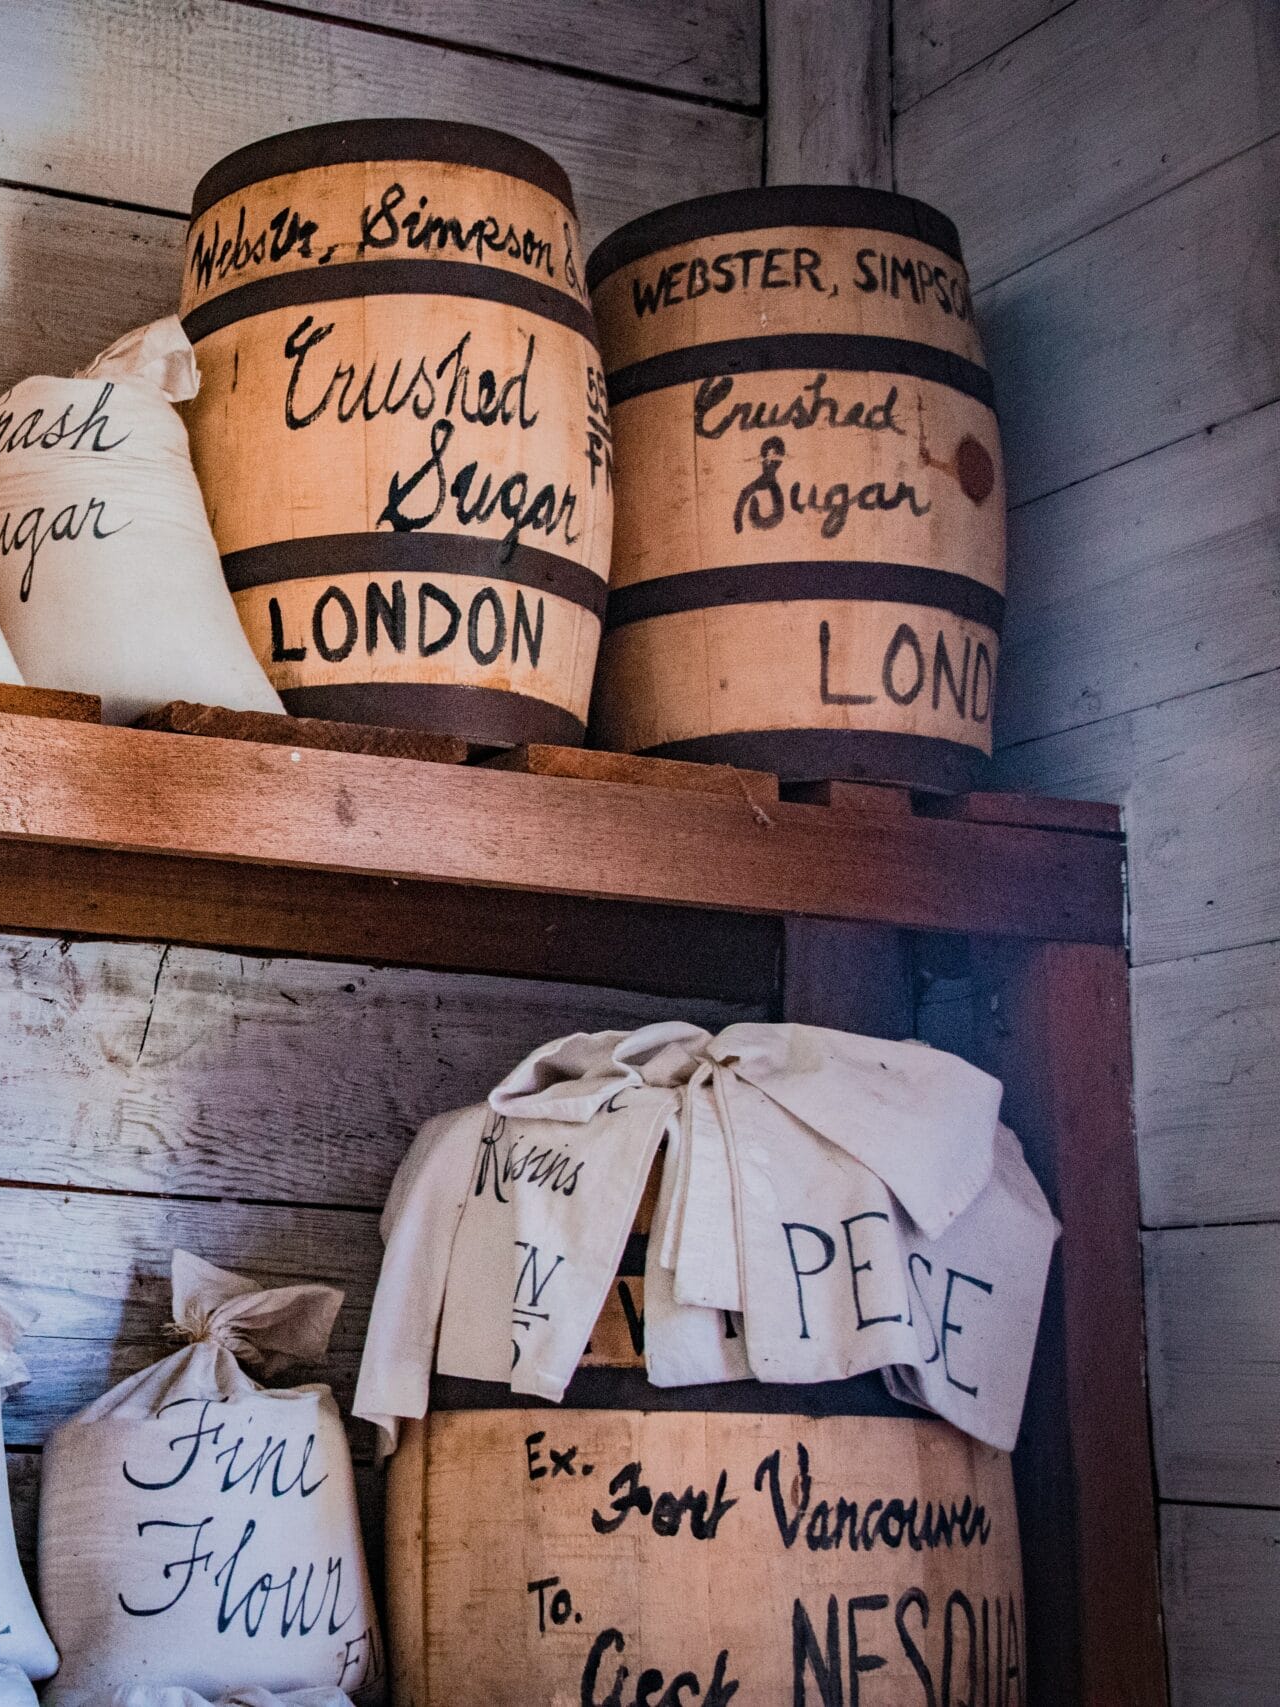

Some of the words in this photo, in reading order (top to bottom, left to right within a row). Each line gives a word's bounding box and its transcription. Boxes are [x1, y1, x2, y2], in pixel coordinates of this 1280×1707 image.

[357, 182, 556, 278] Simpson
[633, 247, 840, 319] WEBSTER,
[284, 315, 541, 431] Crushed
[694, 371, 908, 440] Crushed
[376, 418, 581, 565] Sugar
[732, 435, 932, 539] Sugar
[268, 579, 545, 669] LONDON
[819, 619, 993, 725] LOND
[781, 1211, 994, 1398] PESE
[122, 1396, 330, 1499] Fine
[526, 1431, 595, 1484] Ex.
[591, 1460, 740, 1542] Fort
[753, 1440, 993, 1552] Vancouver
[118, 1515, 359, 1639] Flour
[526, 1574, 584, 1635] To.
